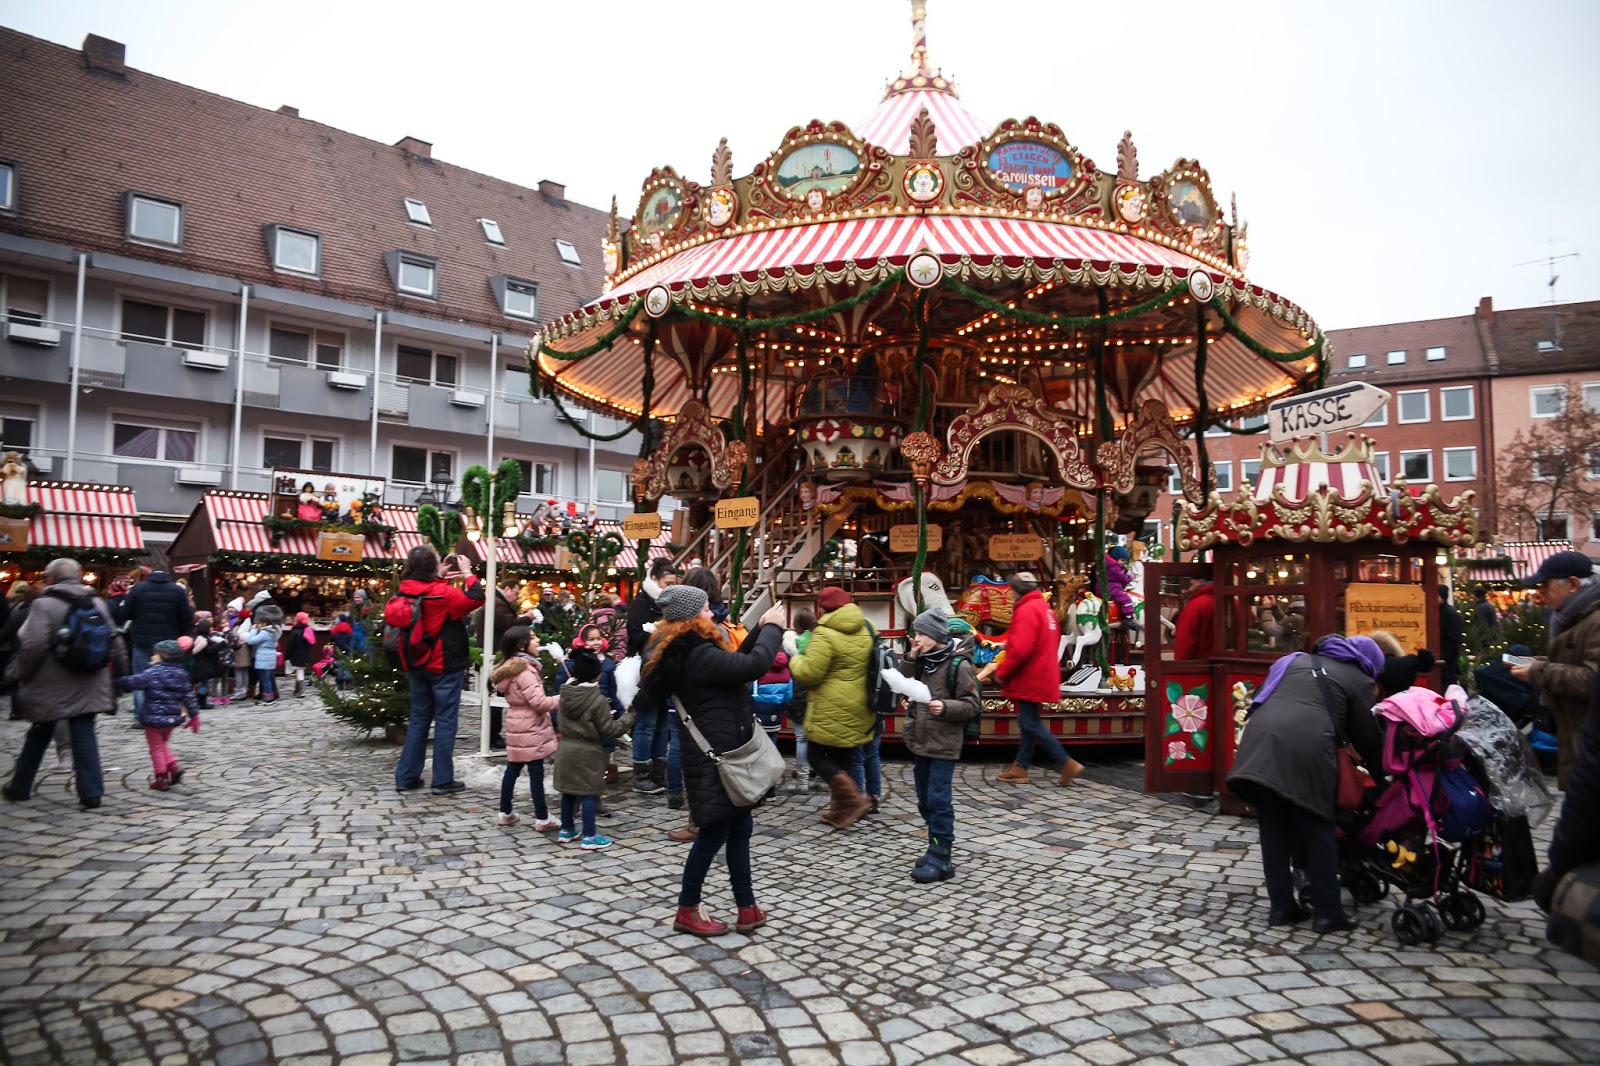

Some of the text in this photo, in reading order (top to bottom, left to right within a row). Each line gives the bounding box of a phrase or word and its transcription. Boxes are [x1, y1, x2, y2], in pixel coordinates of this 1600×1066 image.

[1012, 153, 1049, 164] ETAGEN
[995, 170, 1056, 187] Caroussell
[1280, 393, 1353, 433] KASSE
[717, 507, 757, 520] Eingang
[624, 519, 659, 532] Eingang
[1372, 617, 1419, 629] Kassenhaus
